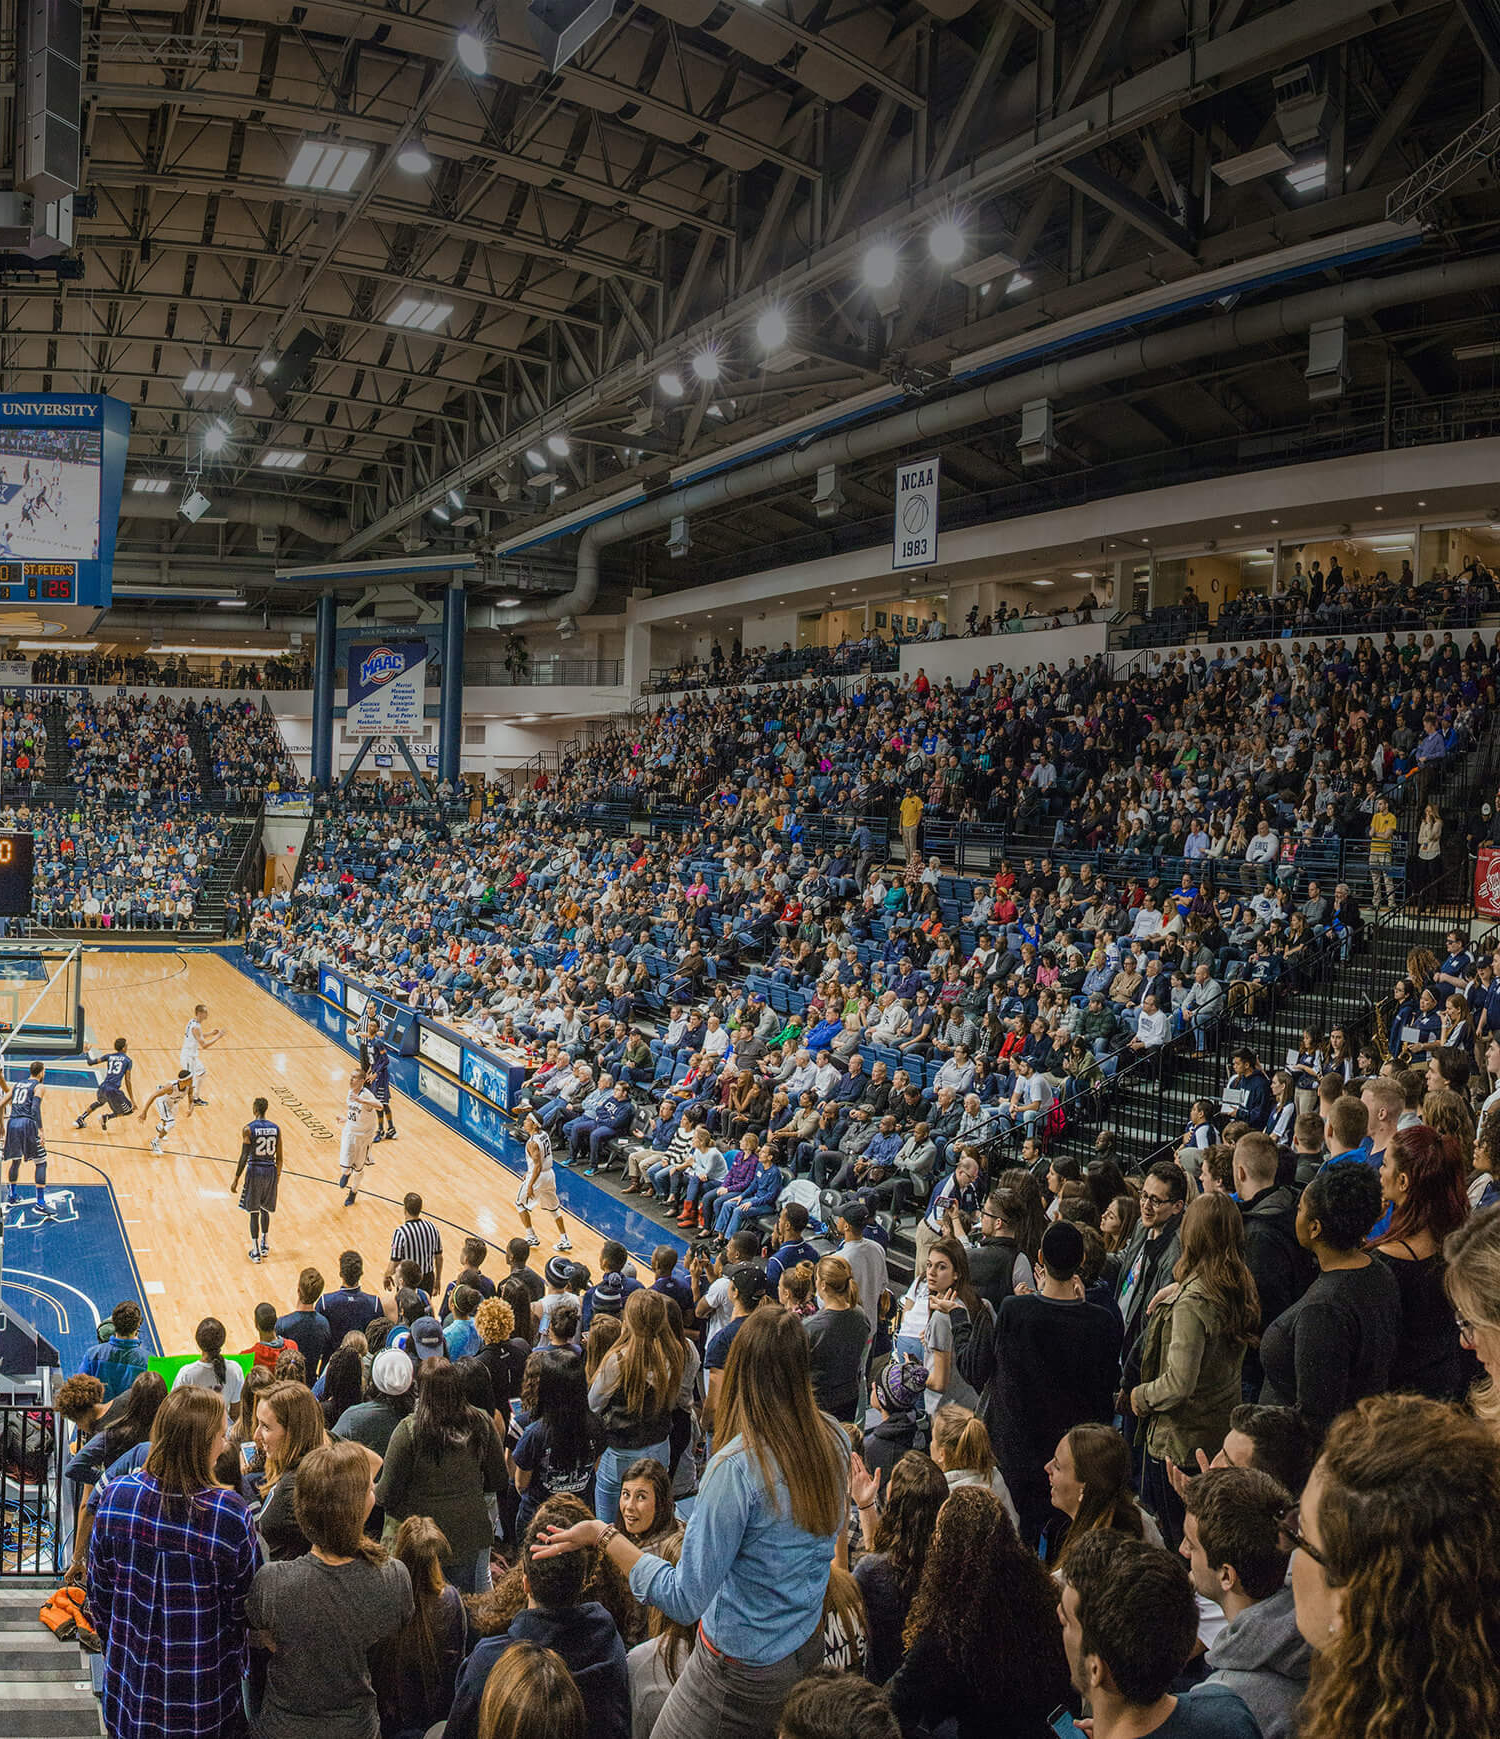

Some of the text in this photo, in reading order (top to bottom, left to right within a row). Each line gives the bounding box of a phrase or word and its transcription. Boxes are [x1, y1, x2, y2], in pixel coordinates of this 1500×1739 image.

[3, 403, 98, 417] UNIVERSITY
[901, 468, 934, 491] NCAA
[902, 538, 928, 557] 1983
[50, 581, 69, 597] 25
[362, 655, 402, 682] MAAC
[369, 743, 439, 754] CONESSI
[107, 1061, 123, 1074] 13
[12, 1088, 28, 1105] 10
[255, 1136, 277, 1156] 20
